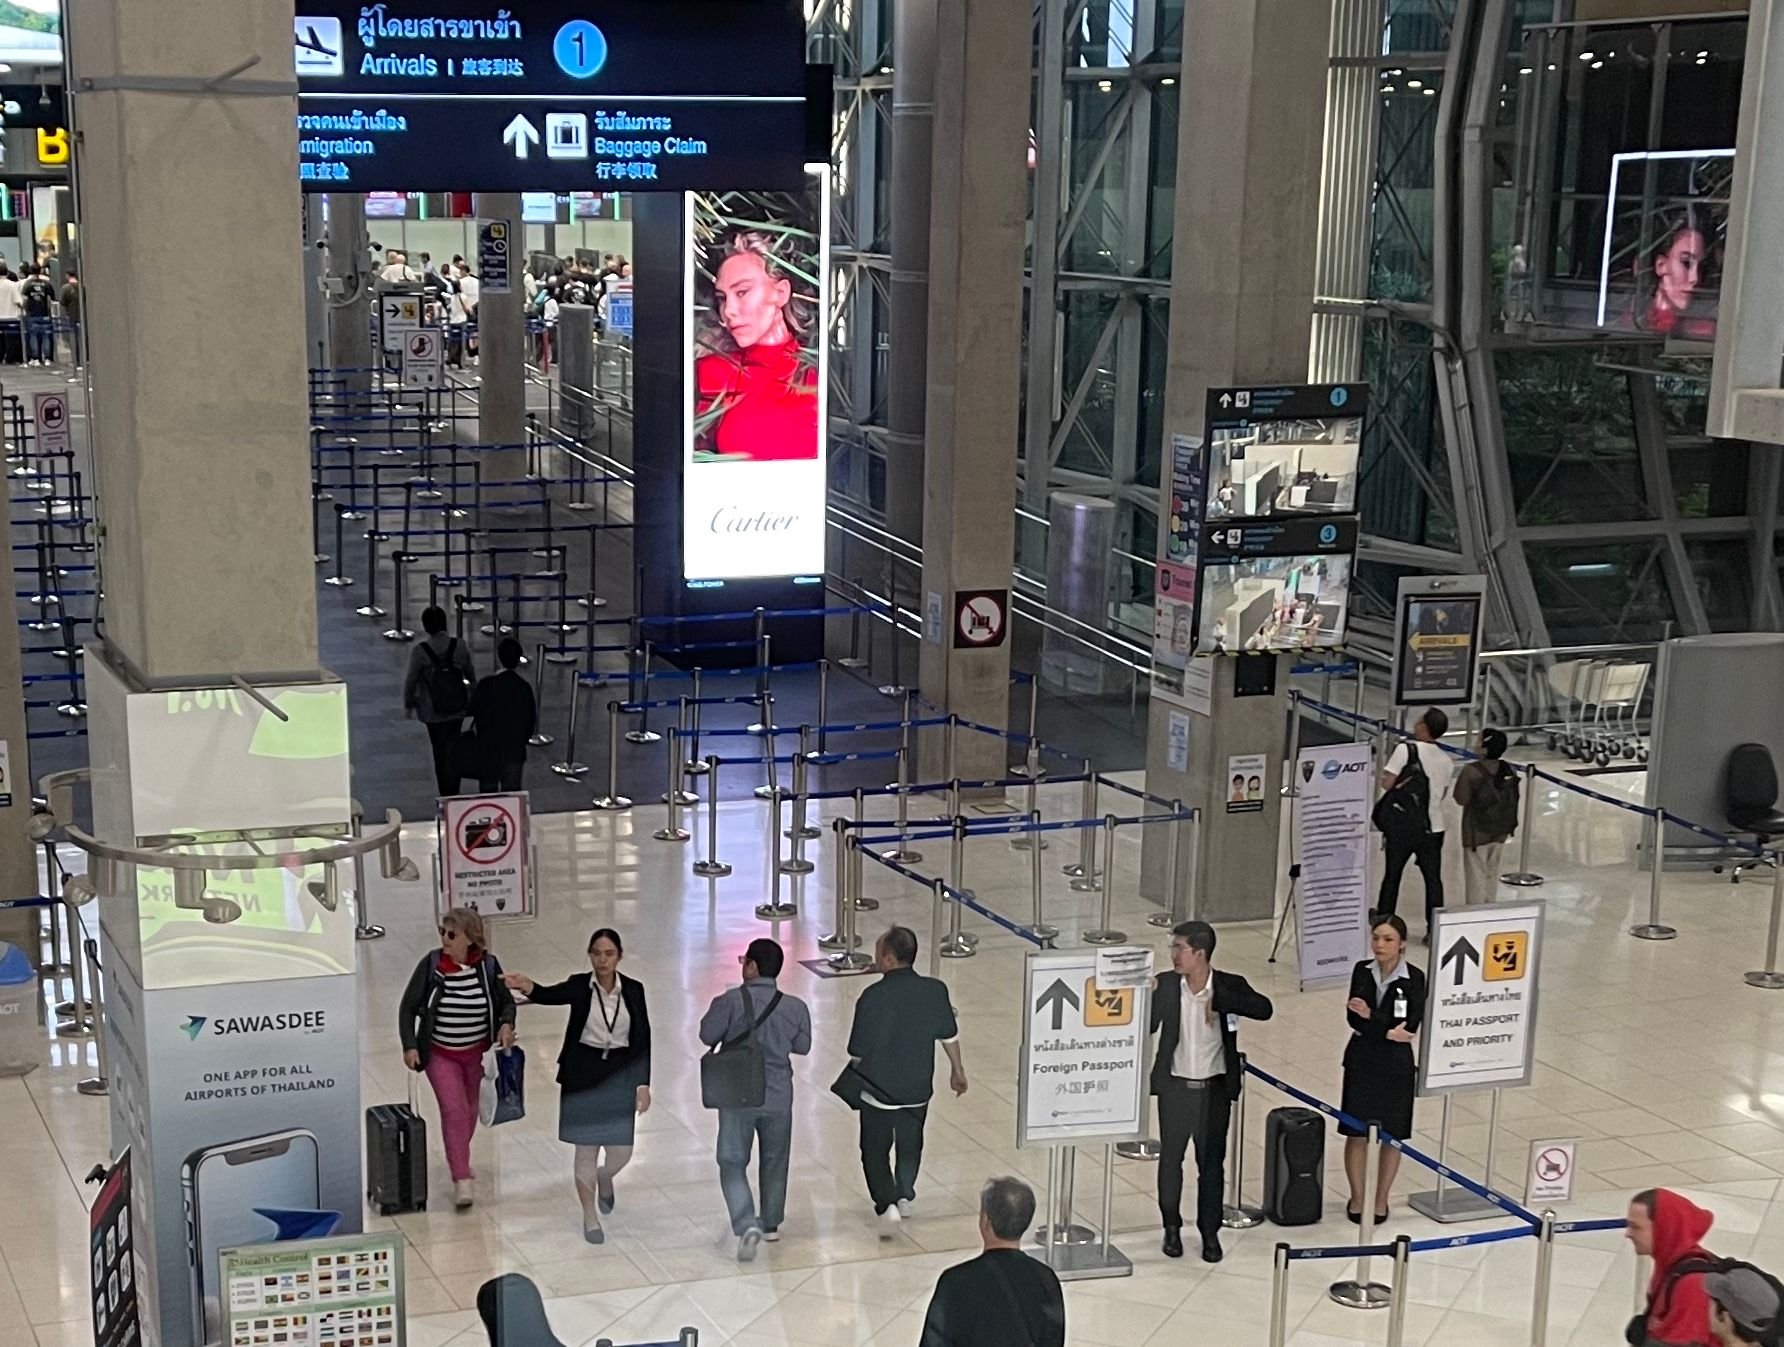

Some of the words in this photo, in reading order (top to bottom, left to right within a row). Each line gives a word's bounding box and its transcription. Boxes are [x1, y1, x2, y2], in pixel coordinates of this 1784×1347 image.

[358, 3, 522, 47] ผู้โดยสารขาเข้า
[571, 31, 586, 67] 1
[360, 53, 438, 76] Arrivals
[298, 137, 375, 158] migration
[594, 137, 661, 158] Baggage
[663, 137, 708, 154] Claim
[710, 505, 800, 534] Cartier
[1341, 761, 1368, 773] AOT
[213, 1010, 325, 1036] SAWASDEE
[1440, 1018, 1463, 1029] THAI
[1465, 1013, 1521, 1027] PASSPORT
[1442, 1038, 1464, 1048] AND
[1466, 1033, 1514, 1047] PRIORITY
[203, 1072, 230, 1084] ONE
[234, 1070, 258, 1081] APP
[262, 1066, 287, 1078] FOR
[290, 1064, 313, 1075] ALL
[1033, 1063, 1079, 1075] Foreign
[1081, 1059, 1134, 1072] Passport
[184, 1086, 247, 1102] AIRPORTS
[250, 1084, 267, 1095] OF
[270, 1078, 335, 1094] THAILAND
